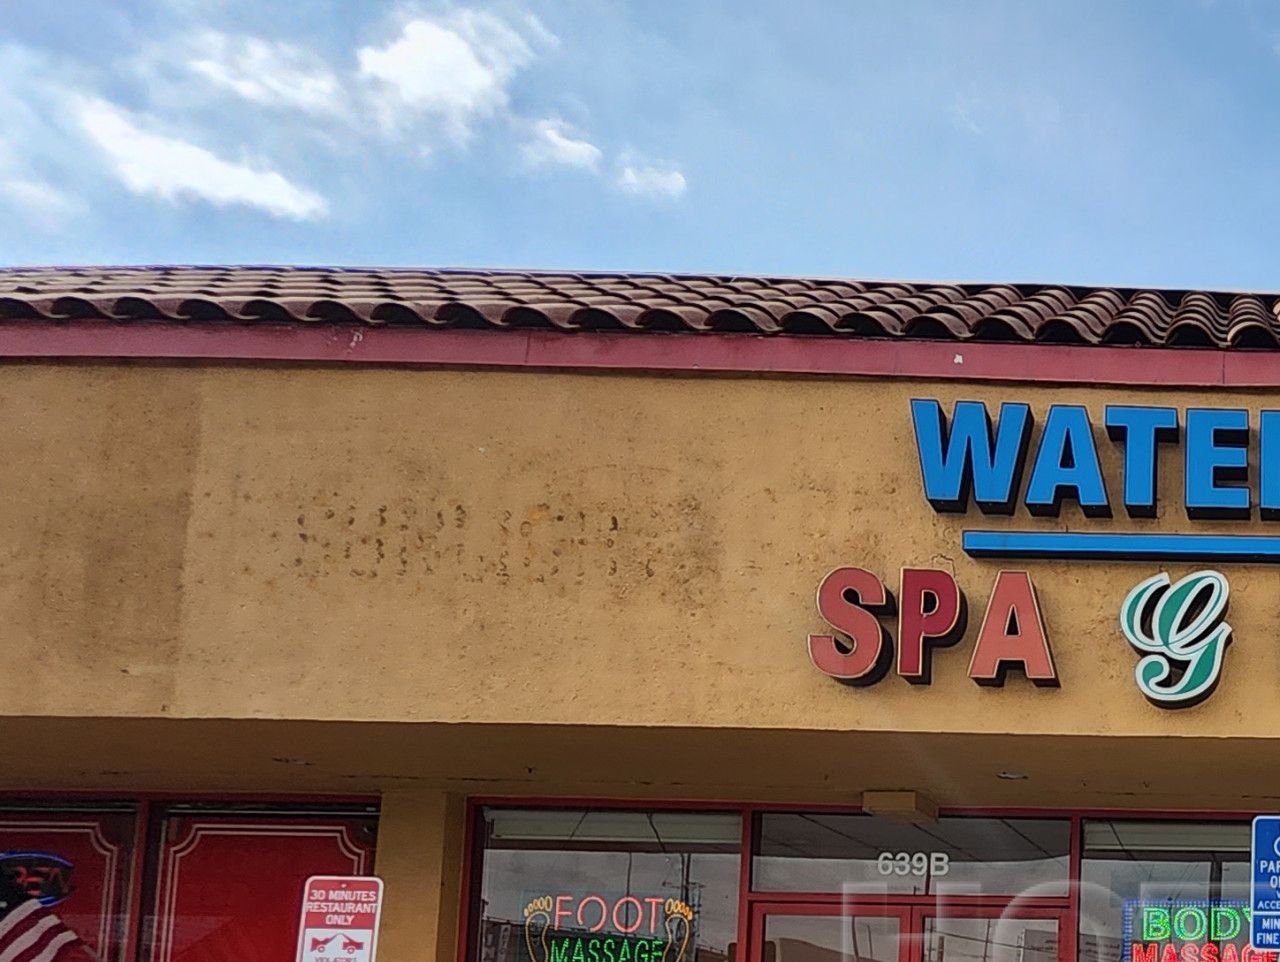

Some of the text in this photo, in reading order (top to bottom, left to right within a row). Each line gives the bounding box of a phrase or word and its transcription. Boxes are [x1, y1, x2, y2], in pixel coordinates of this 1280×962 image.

[806, 566, 1060, 686] SPA
[877, 851, 950, 876] 639B
[309, 889, 377, 902] 30 MINUTES
[304, 902, 379, 914] RESTAURANT
[553, 895, 666, 934] FOOT
[325, 914, 355, 926] ONLY
[1256, 933, 1280, 945] FINE
